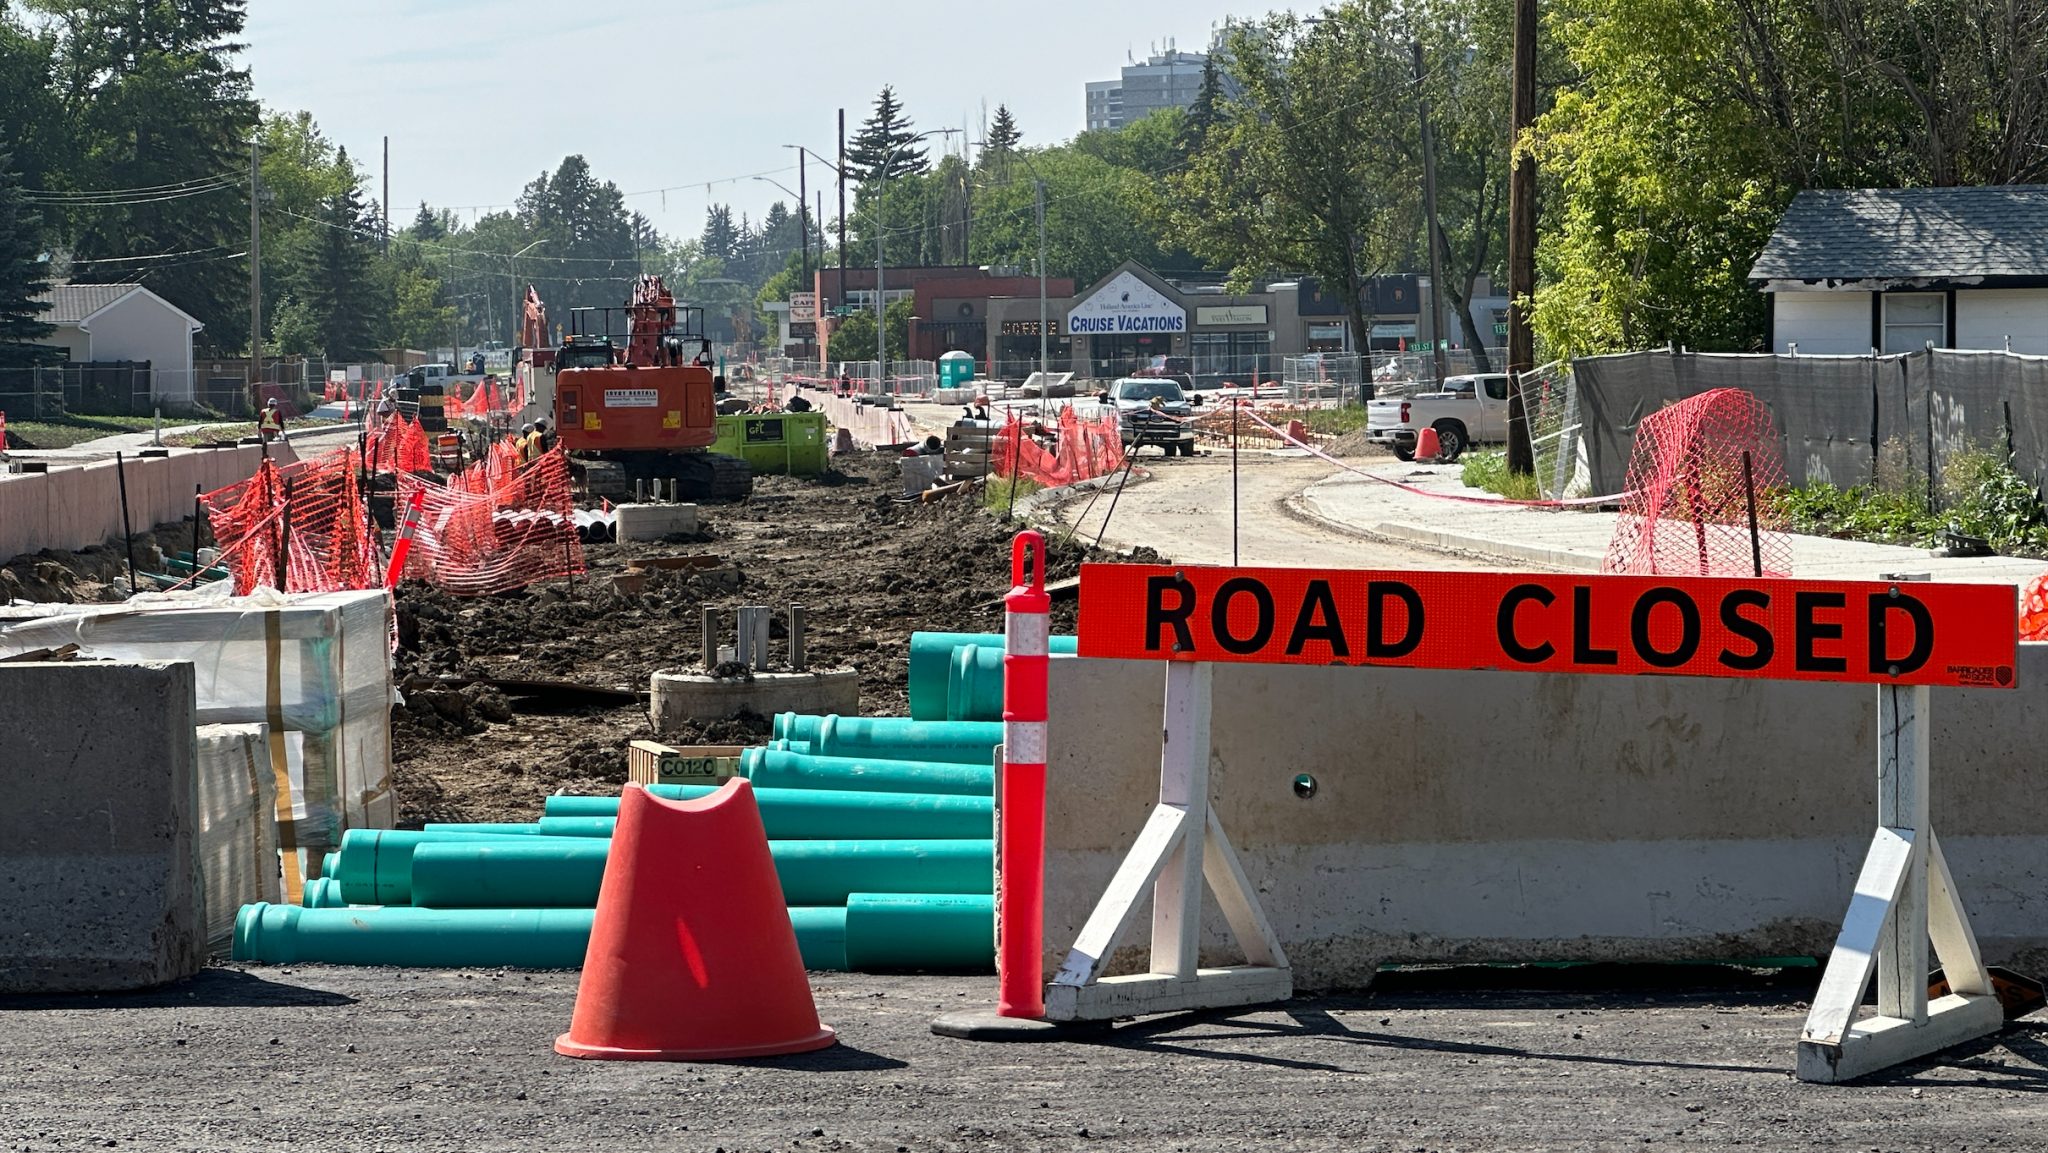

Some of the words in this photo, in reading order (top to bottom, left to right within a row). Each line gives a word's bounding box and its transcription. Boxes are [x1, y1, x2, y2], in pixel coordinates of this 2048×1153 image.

[1003, 321, 1057, 335] COFFE
[1071, 315, 1114, 332] CRUISE
[1118, 315, 1183, 332] VACATIONS
[749, 421, 765, 434] GFL
[1145, 575, 1425, 658] ROAD
[1496, 583, 1935, 675] CLOSED
